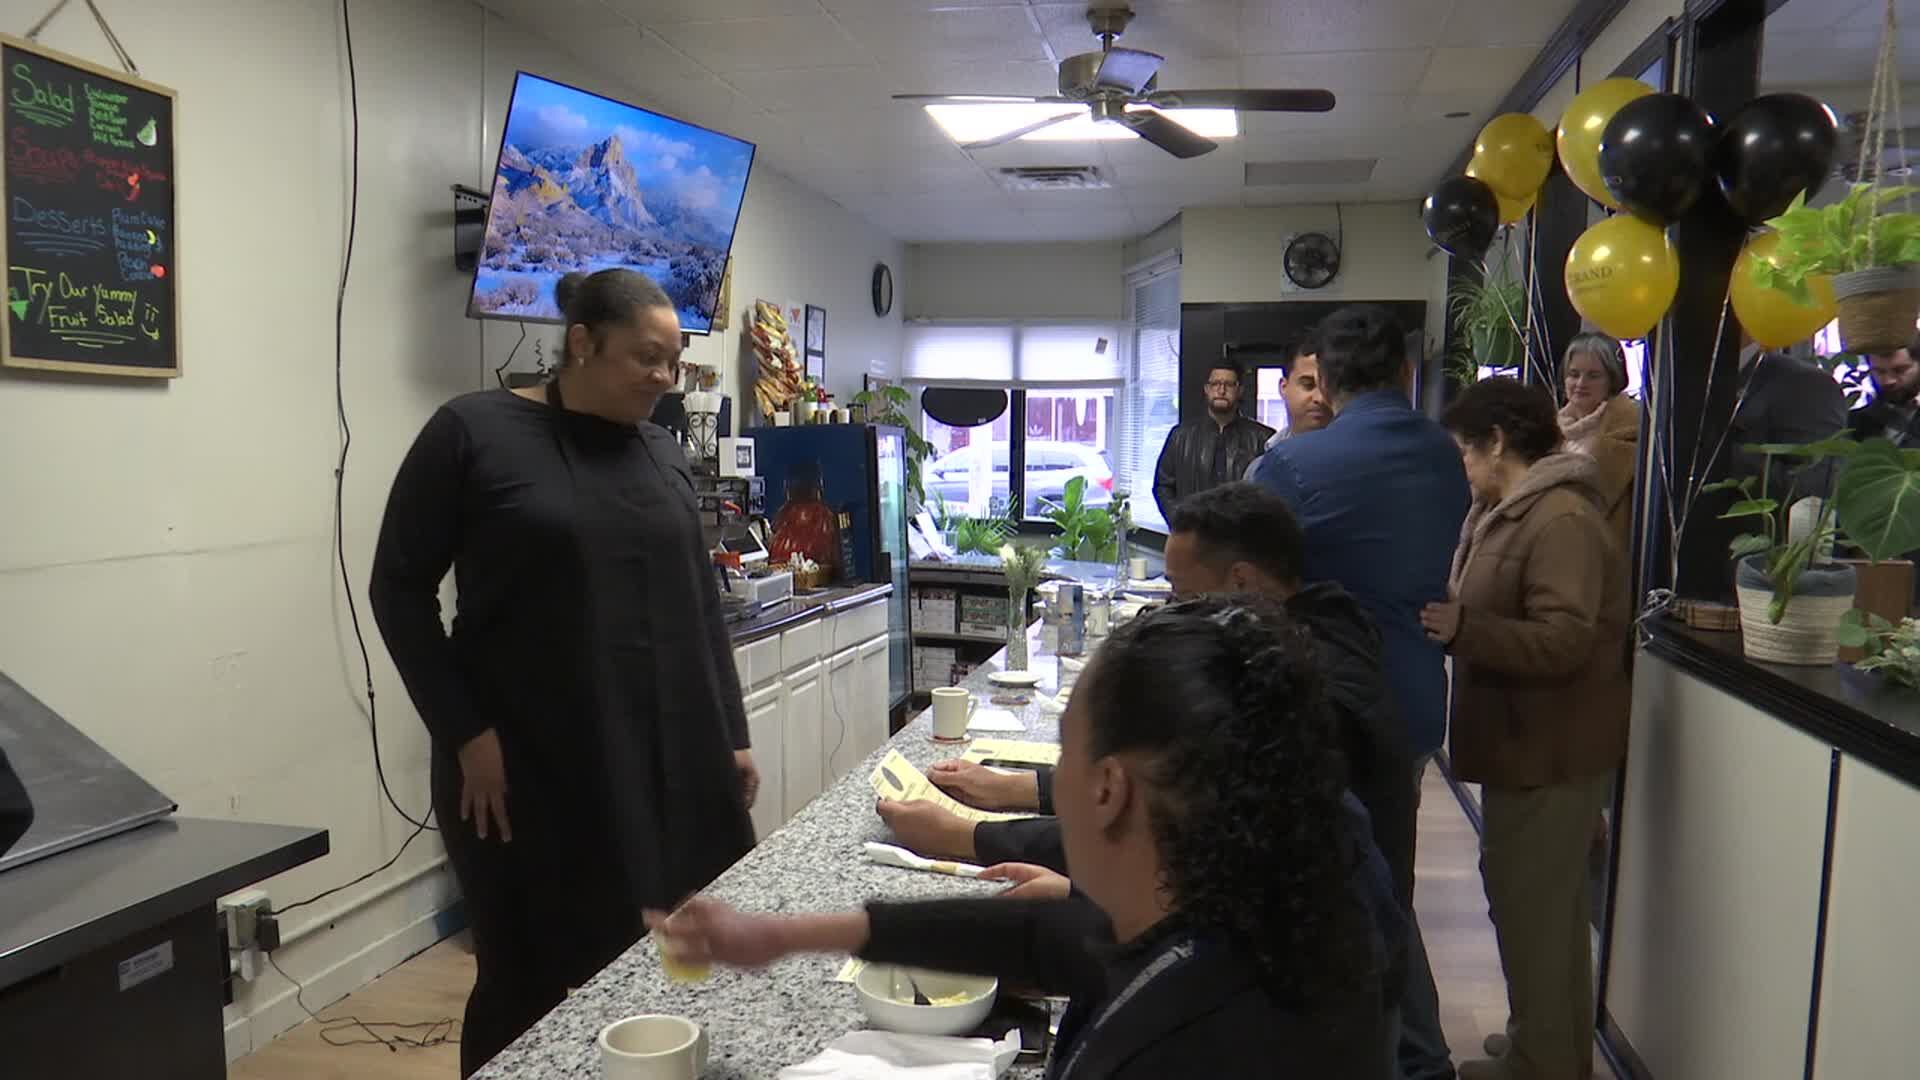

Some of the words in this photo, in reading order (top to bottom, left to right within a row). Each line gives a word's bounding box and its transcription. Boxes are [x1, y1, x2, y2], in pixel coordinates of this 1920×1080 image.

[12, 63, 74, 113] Salad
[13, 196, 105, 235] Desserts
[10, 266, 53, 324] Try
[59, 271, 87, 299] Our
[48, 306, 89, 328] Fruit
[97, 303, 136, 327] Salad
